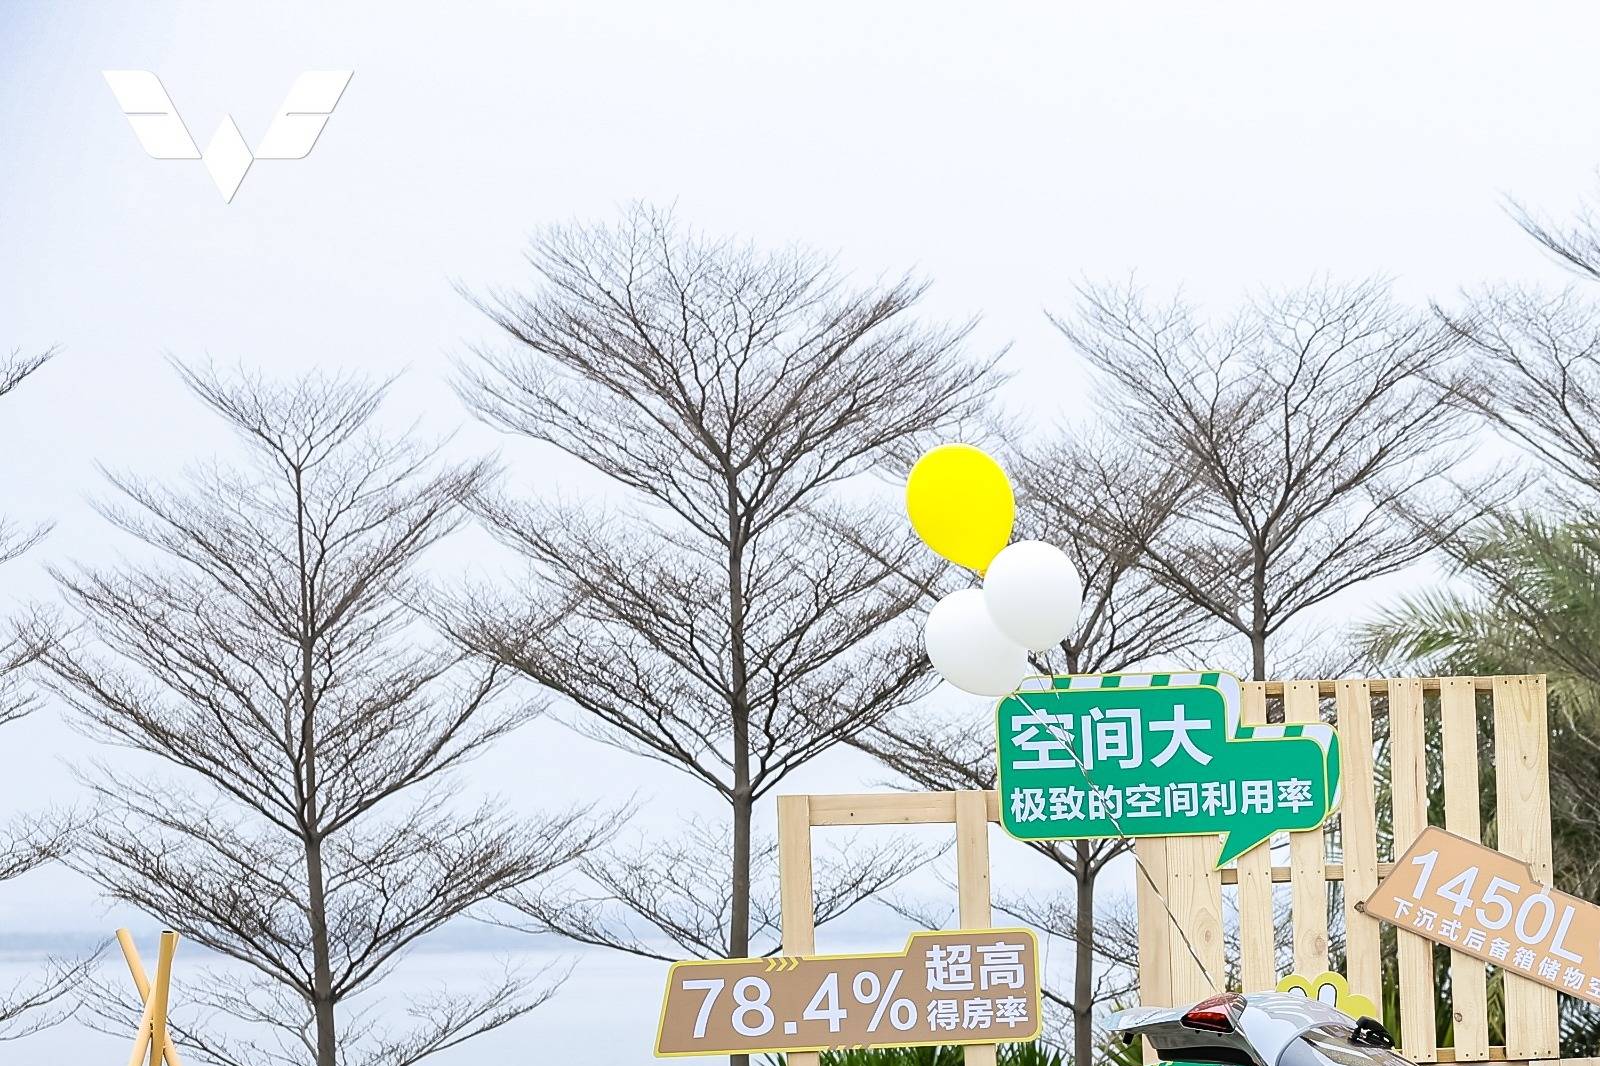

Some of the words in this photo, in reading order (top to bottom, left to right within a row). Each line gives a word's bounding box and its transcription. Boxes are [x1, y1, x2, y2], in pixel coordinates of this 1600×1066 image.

[1011, 704, 1213, 771] 空间大
[1010, 777, 1314, 823] 极致的空间利用率
[1412, 849, 1583, 965] 1450L
[925, 941, 1025, 992] 超高
[682, 969, 918, 1039] 78.4%
[926, 995, 1029, 1032] 得房率
